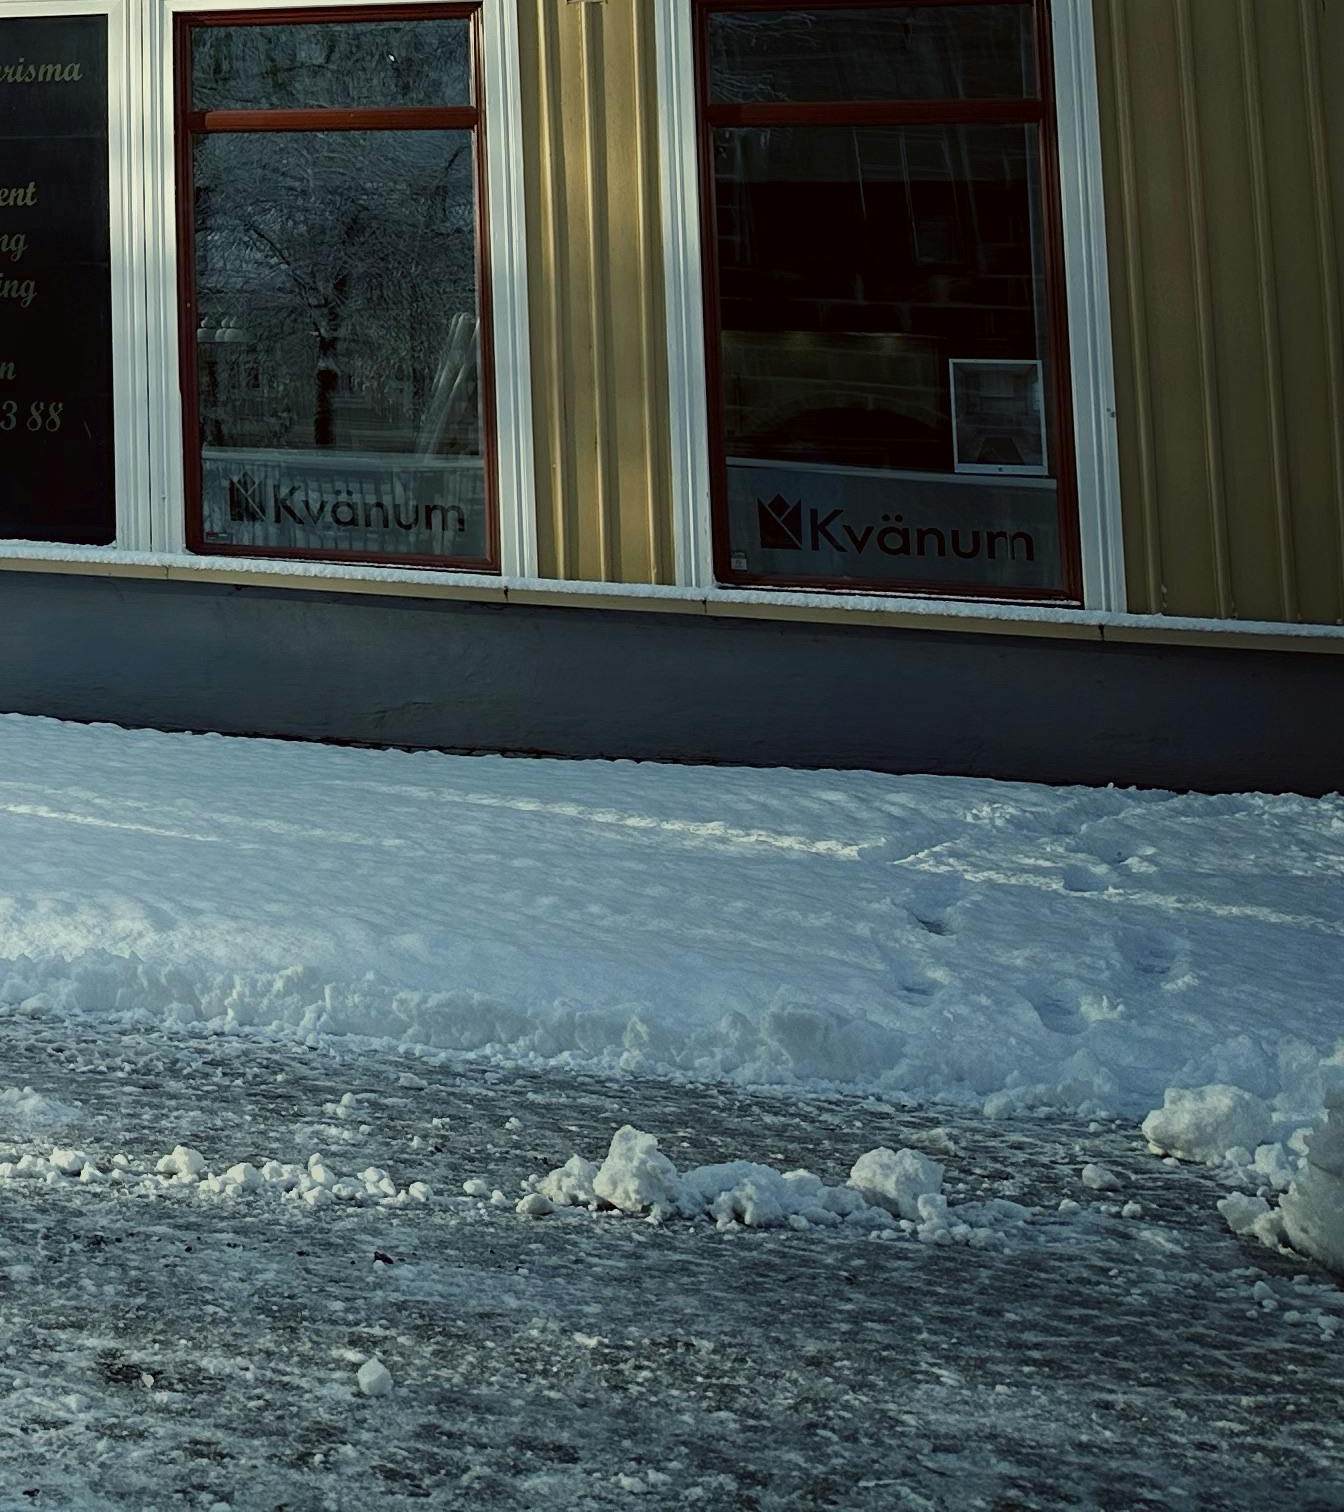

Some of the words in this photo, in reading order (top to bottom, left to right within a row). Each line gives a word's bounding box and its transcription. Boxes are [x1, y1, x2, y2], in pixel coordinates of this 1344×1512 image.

[26, 400, 63, 431] 88
[273, 484, 466, 532] Kvänum
[809, 508, 1035, 561] Kvänum
